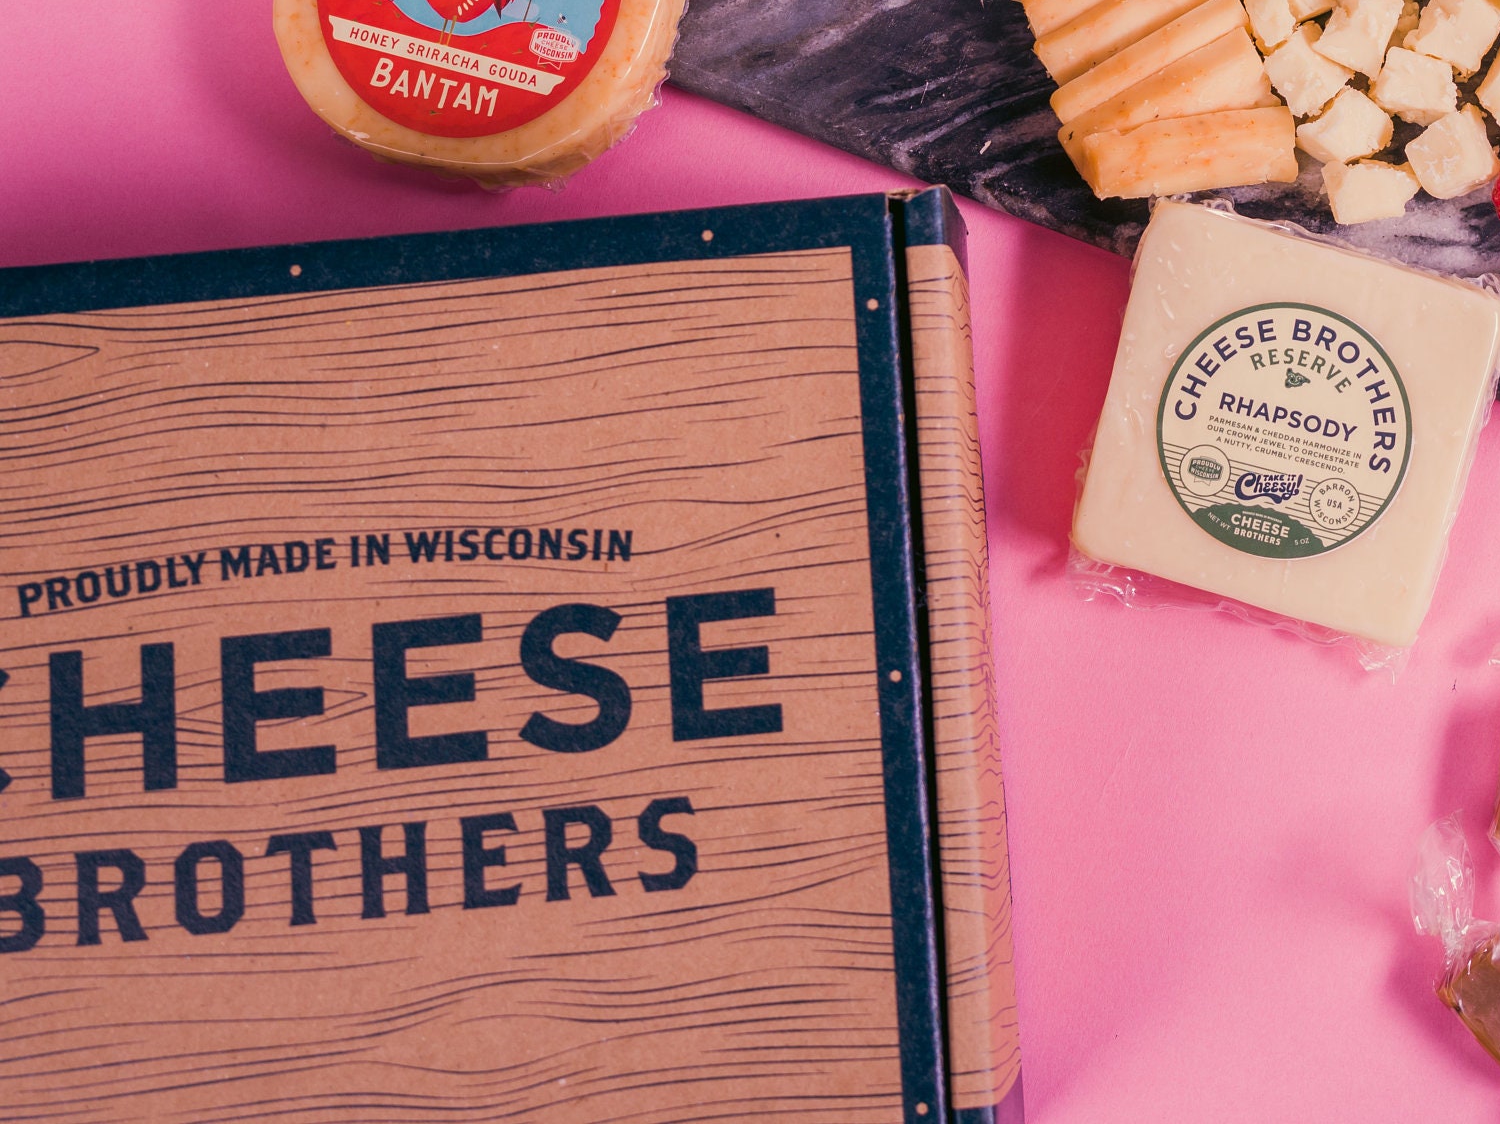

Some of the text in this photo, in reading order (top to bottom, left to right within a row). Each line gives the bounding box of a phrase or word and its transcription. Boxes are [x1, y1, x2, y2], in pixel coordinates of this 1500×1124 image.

[349, 27, 537, 87] HONEY SRIRACHA GOUDA
[534, 43, 573, 59] WISCONSIN
[370, 57, 499, 117] BANTAM
[1250, 348, 1352, 394] RESERVE
[1174, 319, 1397, 474] CHEESE BROTHERS
[1219, 392, 1358, 442] RHAPSODY
[1207, 425, 1224, 433] OUR
[1227, 429, 1257, 441] CROWN
[1259, 437, 1286, 449] JEWEL
[1302, 449, 1360, 468] ORCHESTRATE
[1209, 415, 1252, 432] PARMESAN
[1262, 429, 1300, 443] CHEDDAR
[1303, 439, 1350, 456] HARMONIZE
[1192, 459, 1220, 471] PROUDLY
[1224, 438, 1252, 451] NUTTY,
[1255, 446, 1292, 460] CRUMBLY
[1295, 456, 1345, 474] CRESCENDO.
[1191, 468, 1219, 479] WISCONSIN
[1263, 474, 1280, 482] TAKE
[1319, 483, 1355, 502] BARRON
[1327, 499, 1342, 509] USA
[1208, 512, 1231, 530] NET WT
[1231, 514, 1290, 538] CHEESE
[1314, 500, 1354, 524] WISCONSIN
[1234, 528, 1281, 546] BROTHERS
[18, 528, 634, 617] PROUDLY MADE IN WISCONSIN
[0, 587, 784, 800] HEESE
